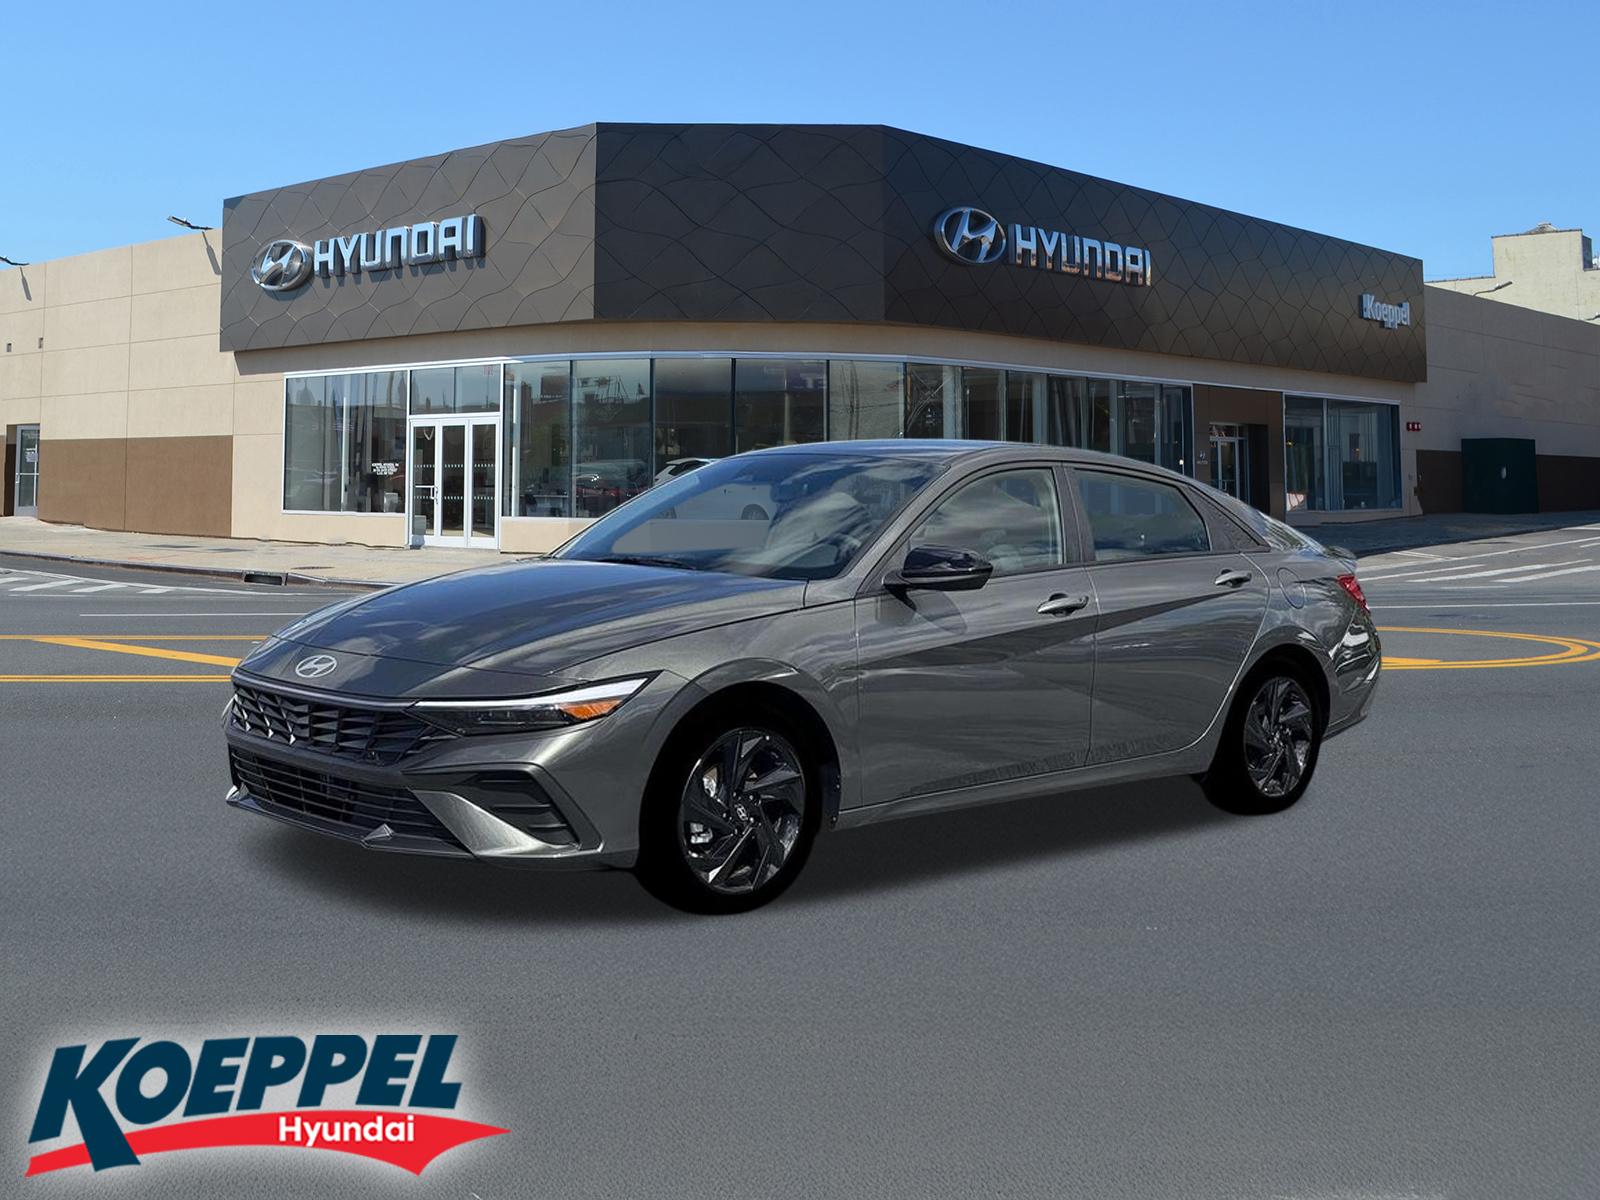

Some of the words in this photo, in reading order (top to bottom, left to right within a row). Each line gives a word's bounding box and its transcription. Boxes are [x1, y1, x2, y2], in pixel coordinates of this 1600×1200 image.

[314, 213, 484, 278] HYUNDAI
[1010, 223, 1152, 287] HYUNDAI
[1361, 292, 1411, 330] Koeppel
